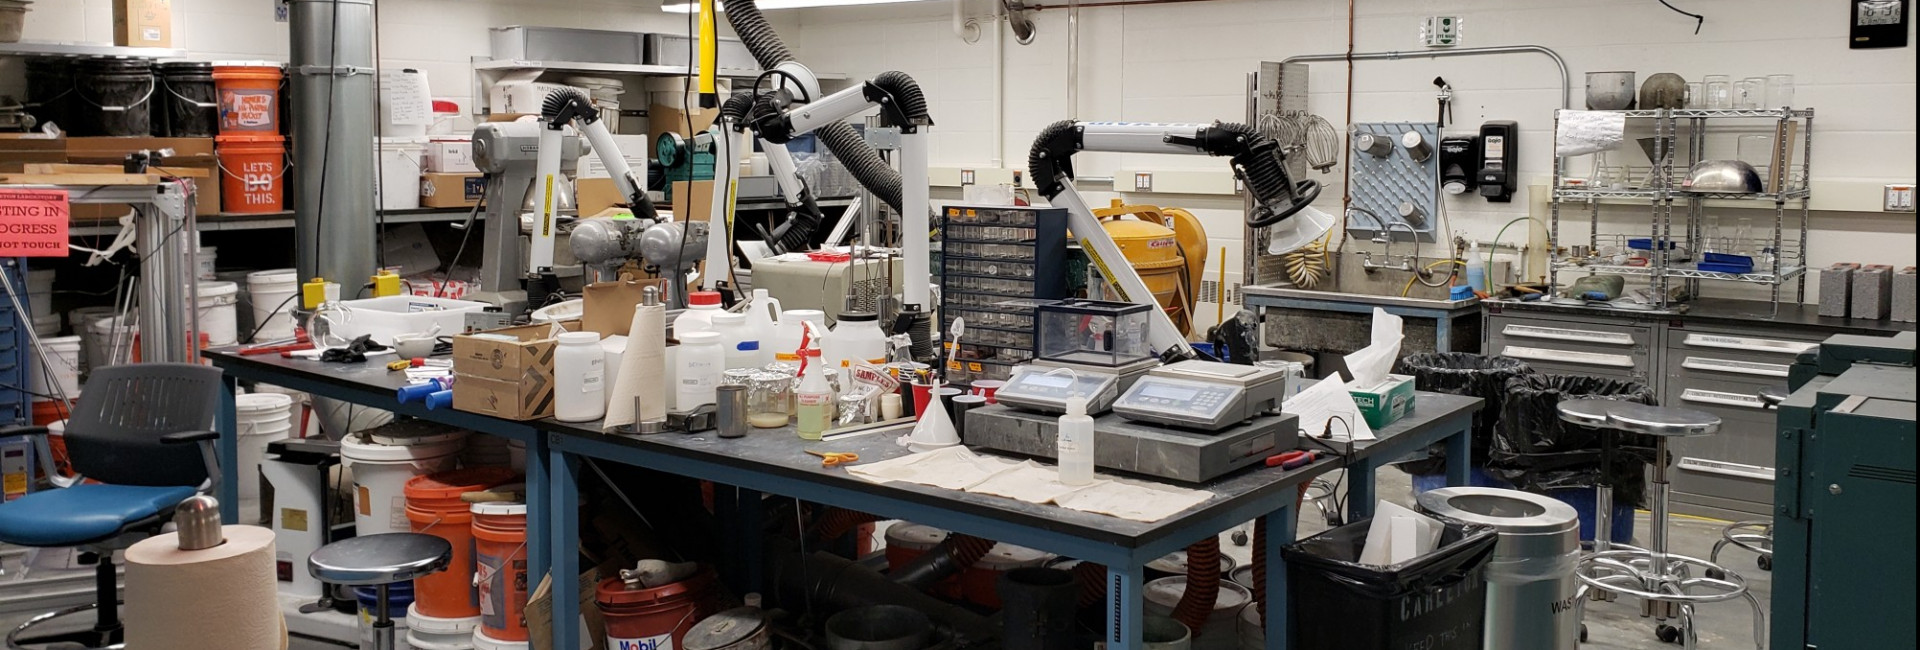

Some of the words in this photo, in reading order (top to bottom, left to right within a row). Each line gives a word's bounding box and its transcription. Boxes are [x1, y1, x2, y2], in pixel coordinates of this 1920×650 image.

[243, 162, 273, 172] LET'S
[244, 174, 273, 192] DO
[244, 193, 276, 205] THIS.
[0, 205, 40, 217] TING
[44, 206, 60, 217] IN
[22, 241, 61, 249] TOUCH
[1354, 397, 1374, 405] TECH
[619, 638, 657, 650] Mobil
